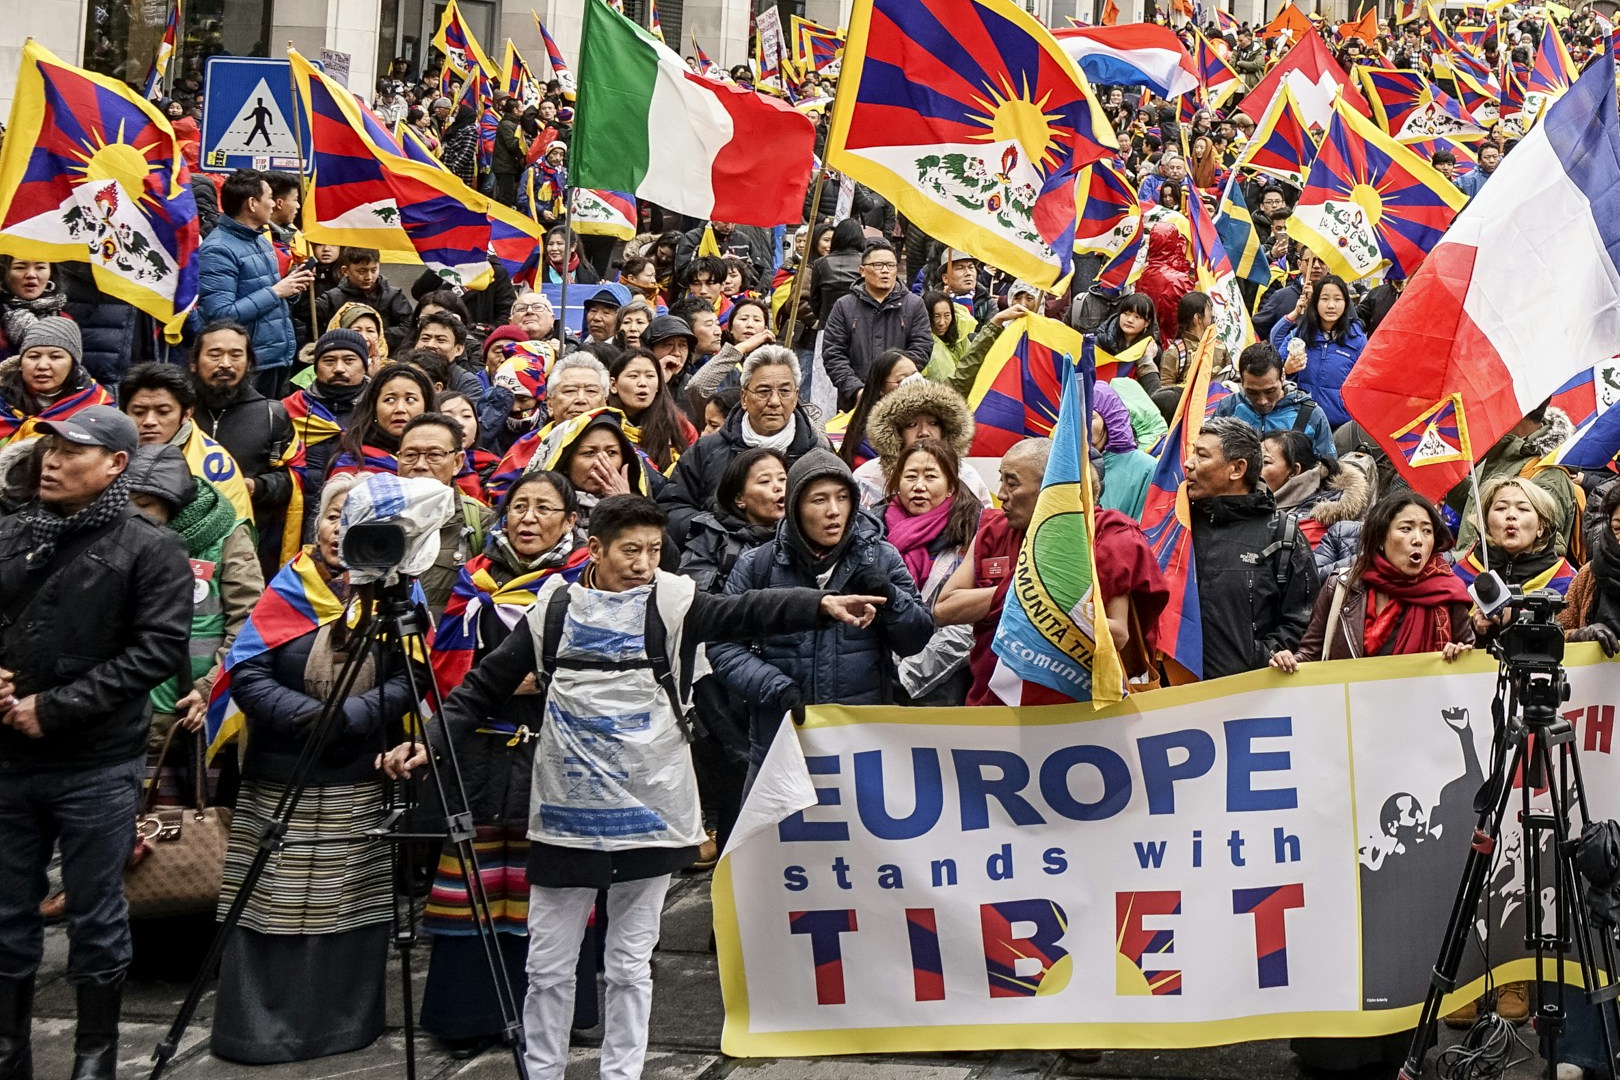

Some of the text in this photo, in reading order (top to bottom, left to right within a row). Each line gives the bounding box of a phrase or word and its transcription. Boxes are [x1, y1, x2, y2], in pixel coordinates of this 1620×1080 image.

[1018, 535, 1072, 644] COMUNITÀ
[779, 716, 1299, 842] EUROPE
[783, 827, 1301, 892] stands with
[788, 882, 1306, 1006] TIBET
